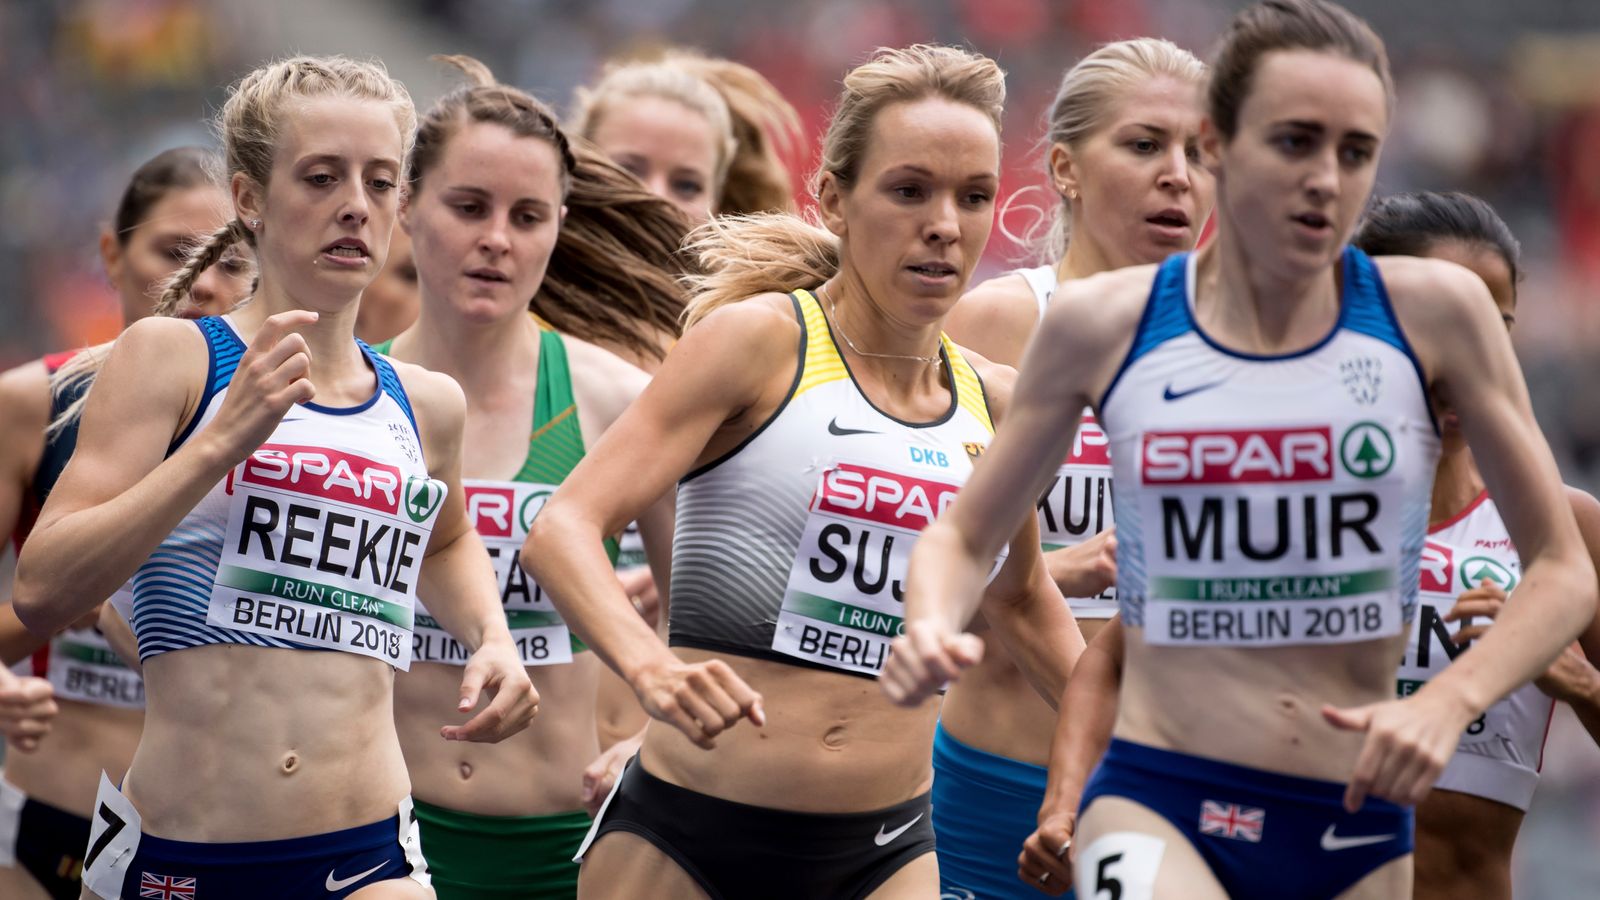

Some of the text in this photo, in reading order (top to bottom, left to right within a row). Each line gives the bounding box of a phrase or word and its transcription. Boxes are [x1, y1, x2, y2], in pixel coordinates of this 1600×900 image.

[250, 450, 396, 506] SPAR
[910, 446, 949, 468] DKB
[1145, 432, 1330, 480] SPAR
[237, 495, 421, 594] REEKIE
[1161, 491, 1383, 562] MUIR
[271, 578, 278, 593] I
[282, 580, 325, 603] RUN
[1198, 580, 1206, 598] I
[1211, 579, 1261, 599] RUN
[232, 597, 400, 660] BERLIN 2018
[838, 607, 845, 623] I
[850, 608, 892, 634] RUN
[1169, 608, 1290, 640] BERLIN
[1304, 602, 1382, 637] 2018
[799, 624, 893, 670] BERLI
[84, 800, 126, 871] 7
[1096, 851, 1125, 900] 5
